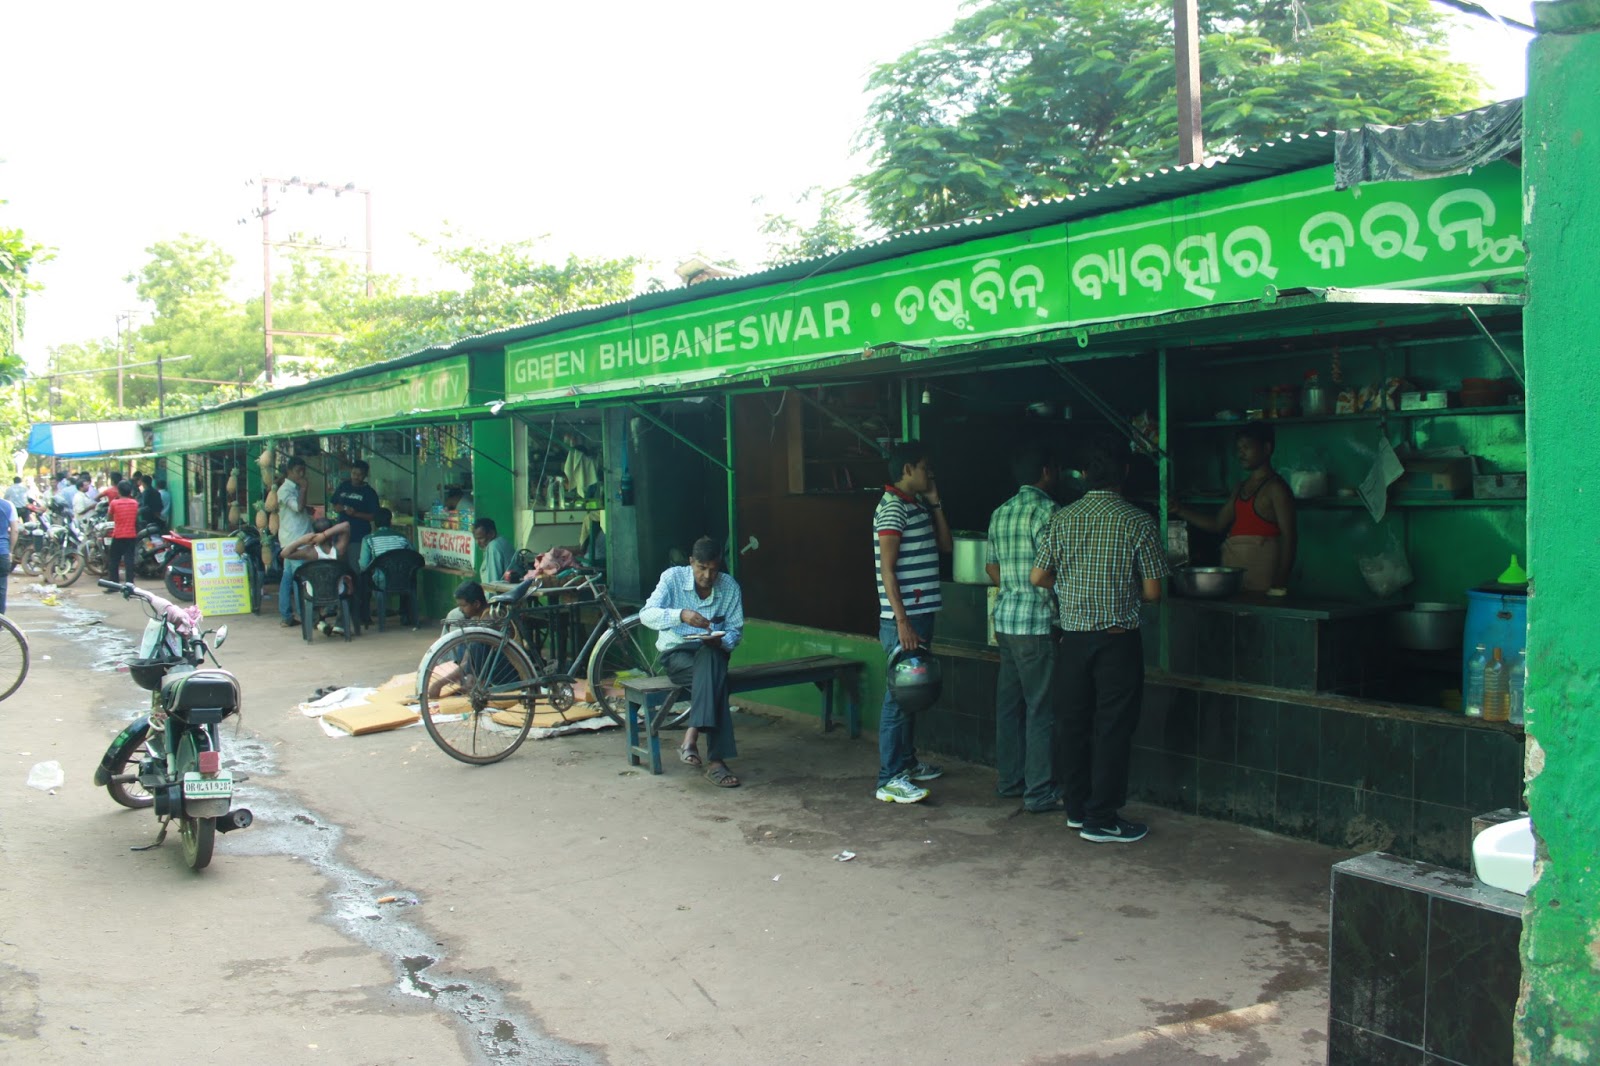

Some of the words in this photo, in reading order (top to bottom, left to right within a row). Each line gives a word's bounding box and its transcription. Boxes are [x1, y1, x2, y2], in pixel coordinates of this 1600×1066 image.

[514, 348, 585, 384] GREEN
[600, 299, 852, 371] BHUBANESWAR
[394, 381, 426, 406] YOUR
[431, 374, 459, 401] CITY
[205, 542, 217, 551] LIC
[439, 532, 472, 555] CENTRE
